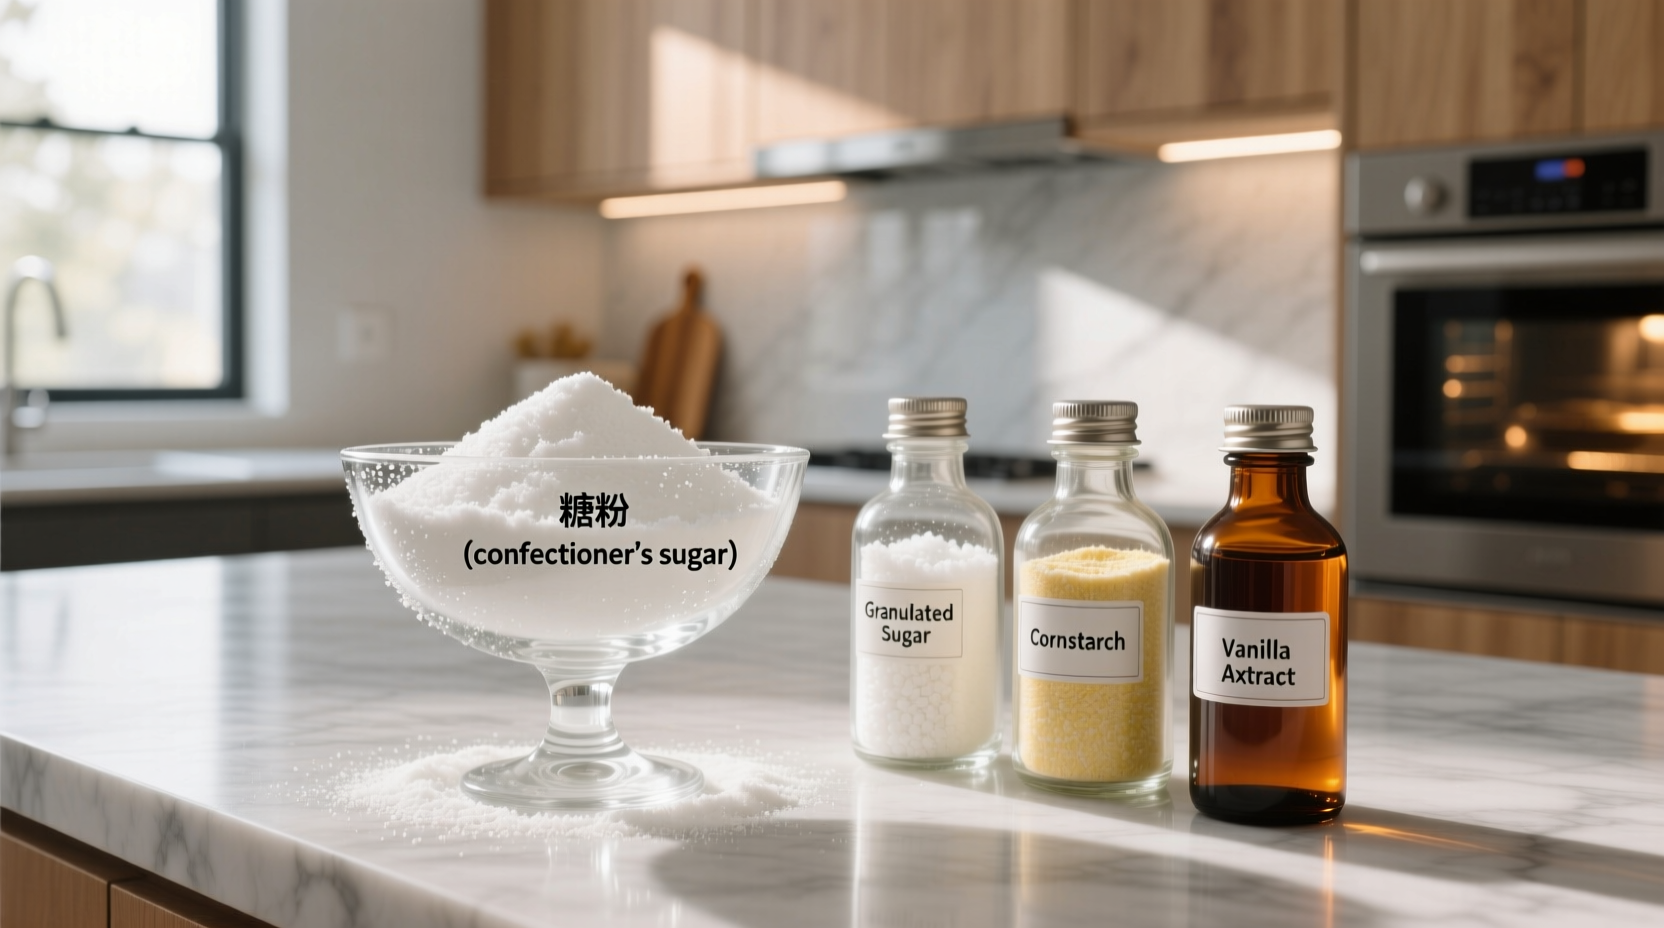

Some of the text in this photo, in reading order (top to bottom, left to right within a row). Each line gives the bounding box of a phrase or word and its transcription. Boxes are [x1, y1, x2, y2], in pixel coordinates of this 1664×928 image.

[864, 602, 954, 623] Granulated
[881, 625, 932, 648] Sugar
[1030, 627, 1126, 652] Cornstarch
[1221, 637, 1291, 661] Vanilla
[1221, 663, 1297, 687] Axtract
